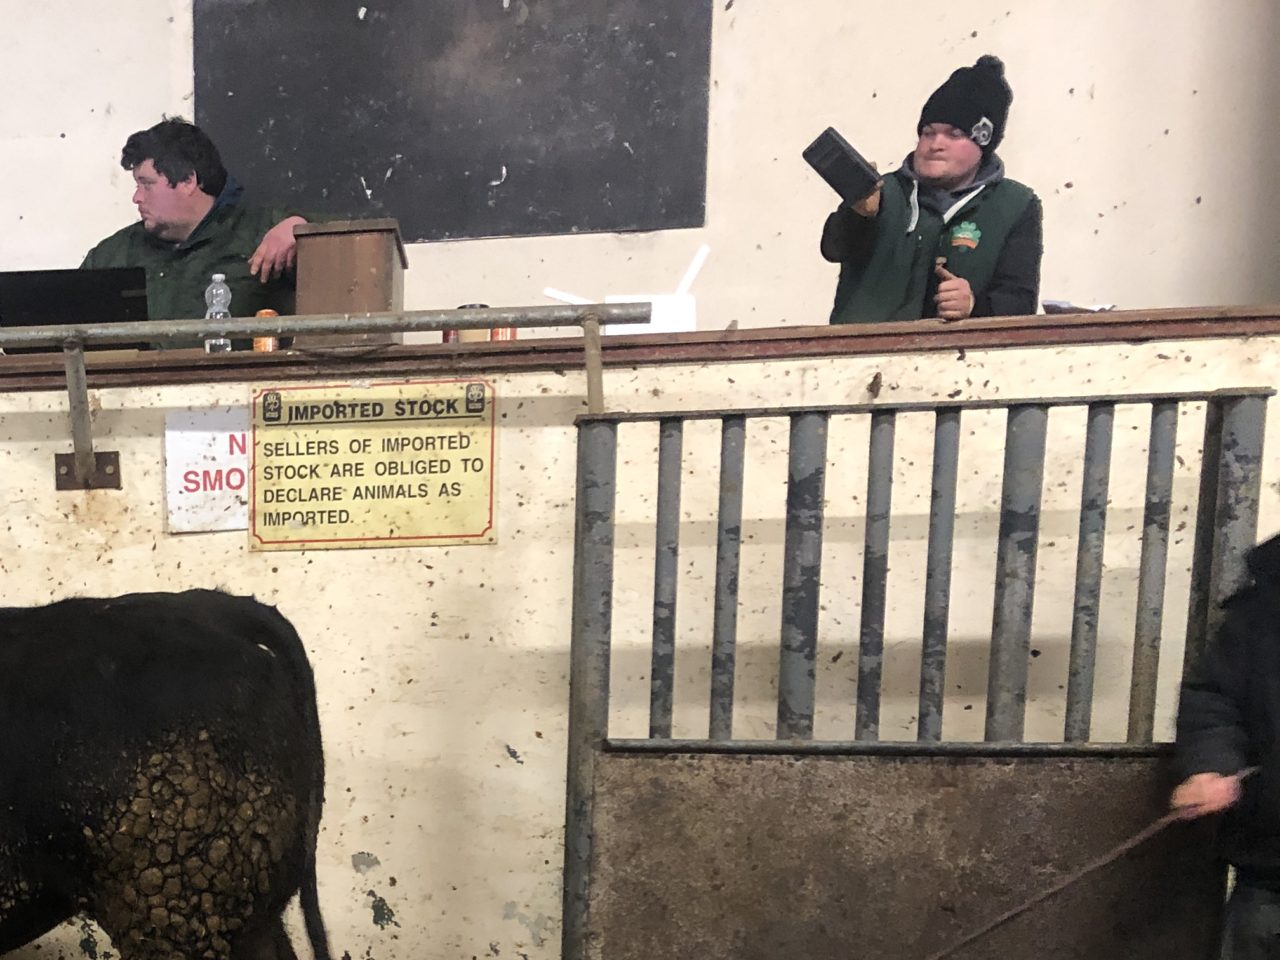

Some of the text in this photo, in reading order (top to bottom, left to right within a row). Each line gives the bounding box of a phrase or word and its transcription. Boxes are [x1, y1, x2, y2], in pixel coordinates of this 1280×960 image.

[288, 399, 458, 421] IMPORTED STOCK
[229, 433, 246, 455] N
[263, 435, 471, 457] SELLERS OF IMPORTED
[183, 467, 245, 493] SMO
[263, 458, 484, 480] STOCK ARE OBLIGED TO
[263, 482, 461, 503] DECLARE ANIMALS AS
[263, 510, 354, 526] IMPORTED.
